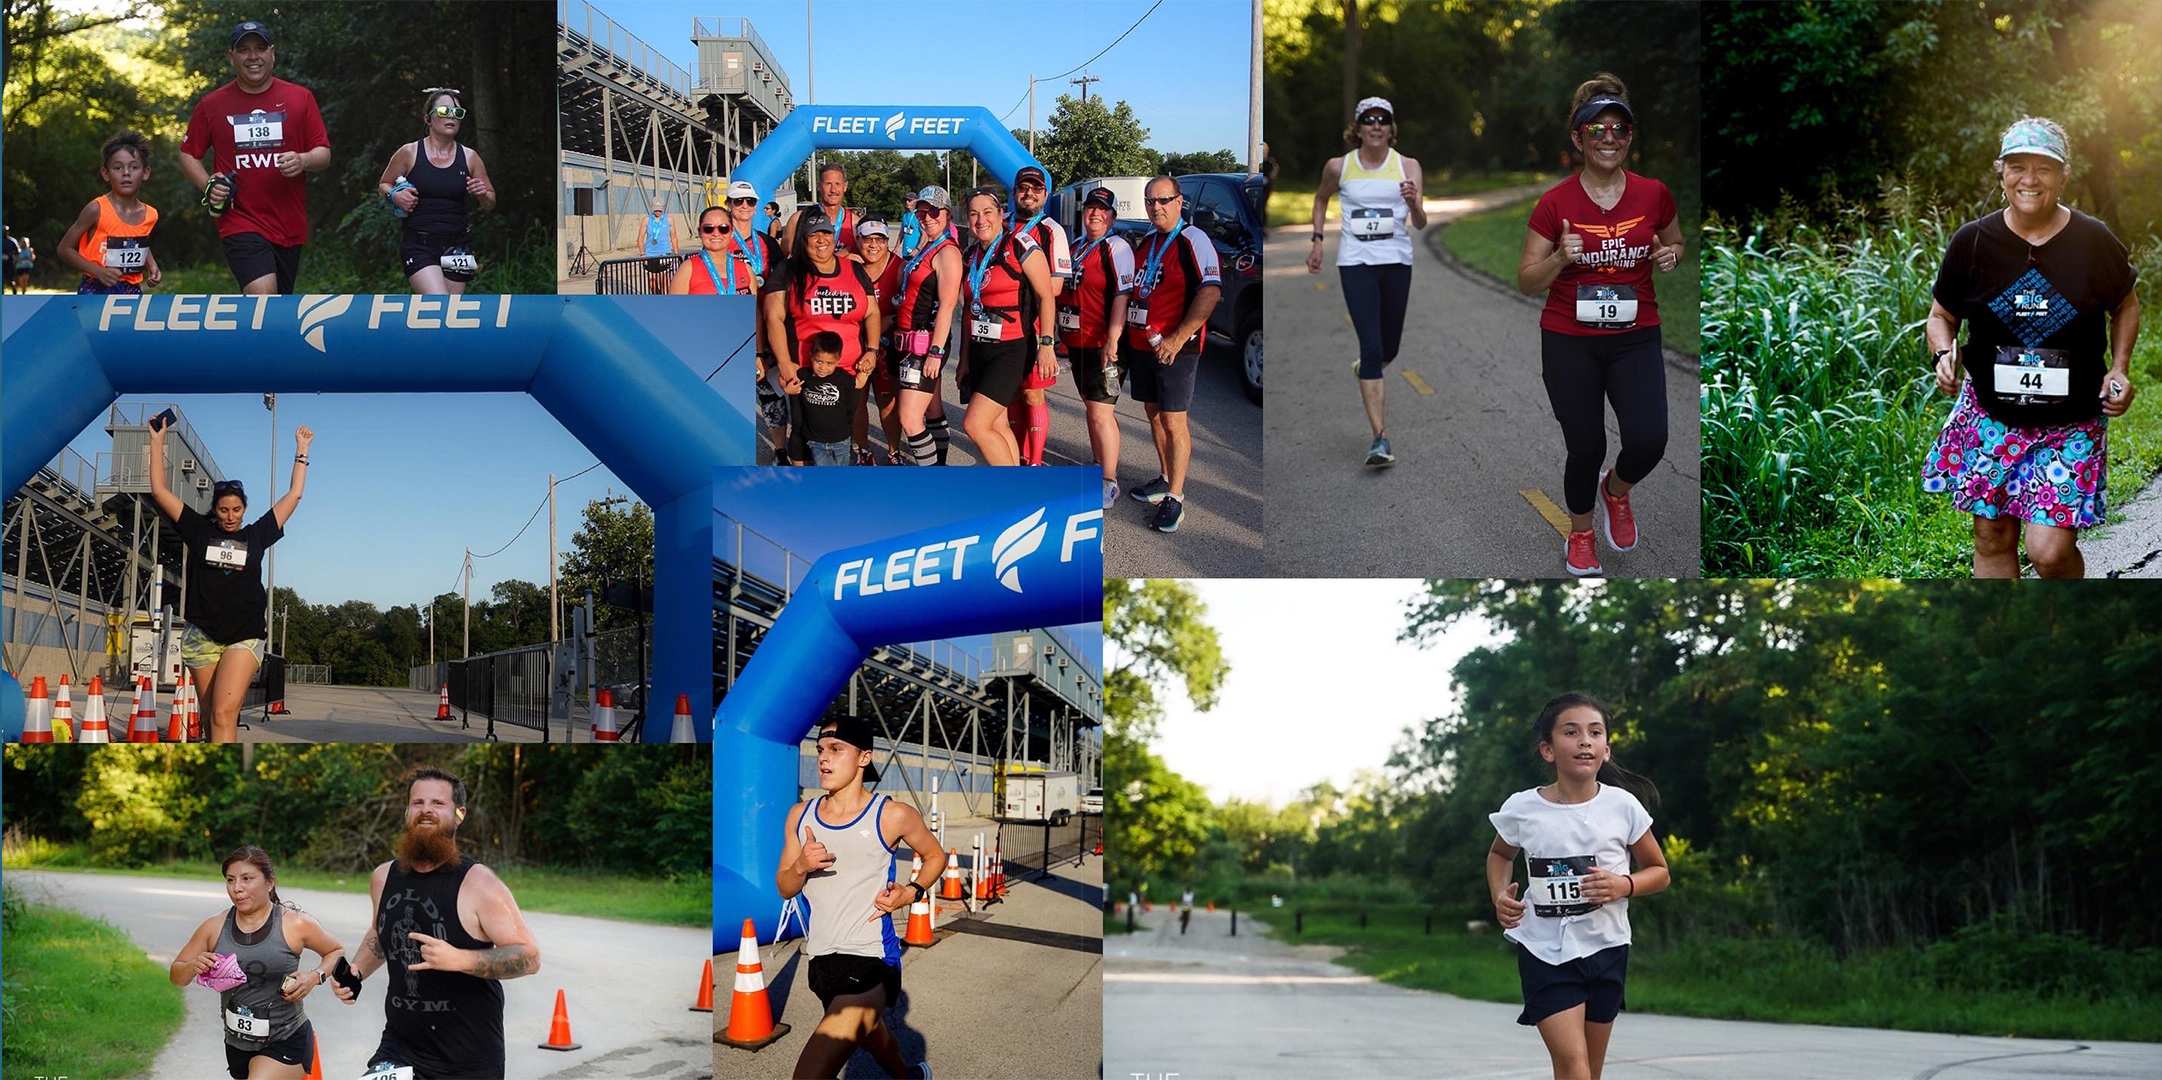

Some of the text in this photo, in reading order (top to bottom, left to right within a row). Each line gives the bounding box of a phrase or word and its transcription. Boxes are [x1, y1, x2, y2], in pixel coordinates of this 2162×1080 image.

[812, 116, 966, 135] FLEET FEET
[247, 126, 270, 138] 138
[1366, 221, 1379, 231] 47
[1601, 237, 1626, 250] EPIC
[119, 252, 141, 264] 122
[452, 258, 469, 268] 121
[2002, 268, 2038, 298] TOGETHER
[814, 289, 838, 297] fueled
[2022, 294, 2043, 304] BIG
[811, 297, 853, 316] BEEF
[1599, 304, 1618, 319] 19
[2021, 302, 2040, 310] RUN
[98, 294, 513, 332] FLEET FEET
[1130, 311, 1138, 320] 17
[1062, 316, 1070, 325] 16
[2042, 308, 2078, 338] TOGETHER
[977, 324, 989, 335] 35
[2024, 354, 2041, 362] BIG
[2019, 372, 2043, 389] 44
[220, 550, 233, 561] 96
[834, 508, 1103, 601] FLEET F
[1553, 864, 1570, 872] BIG
[1546, 882, 1582, 900] 115
[237, 1018, 253, 1032] 83
